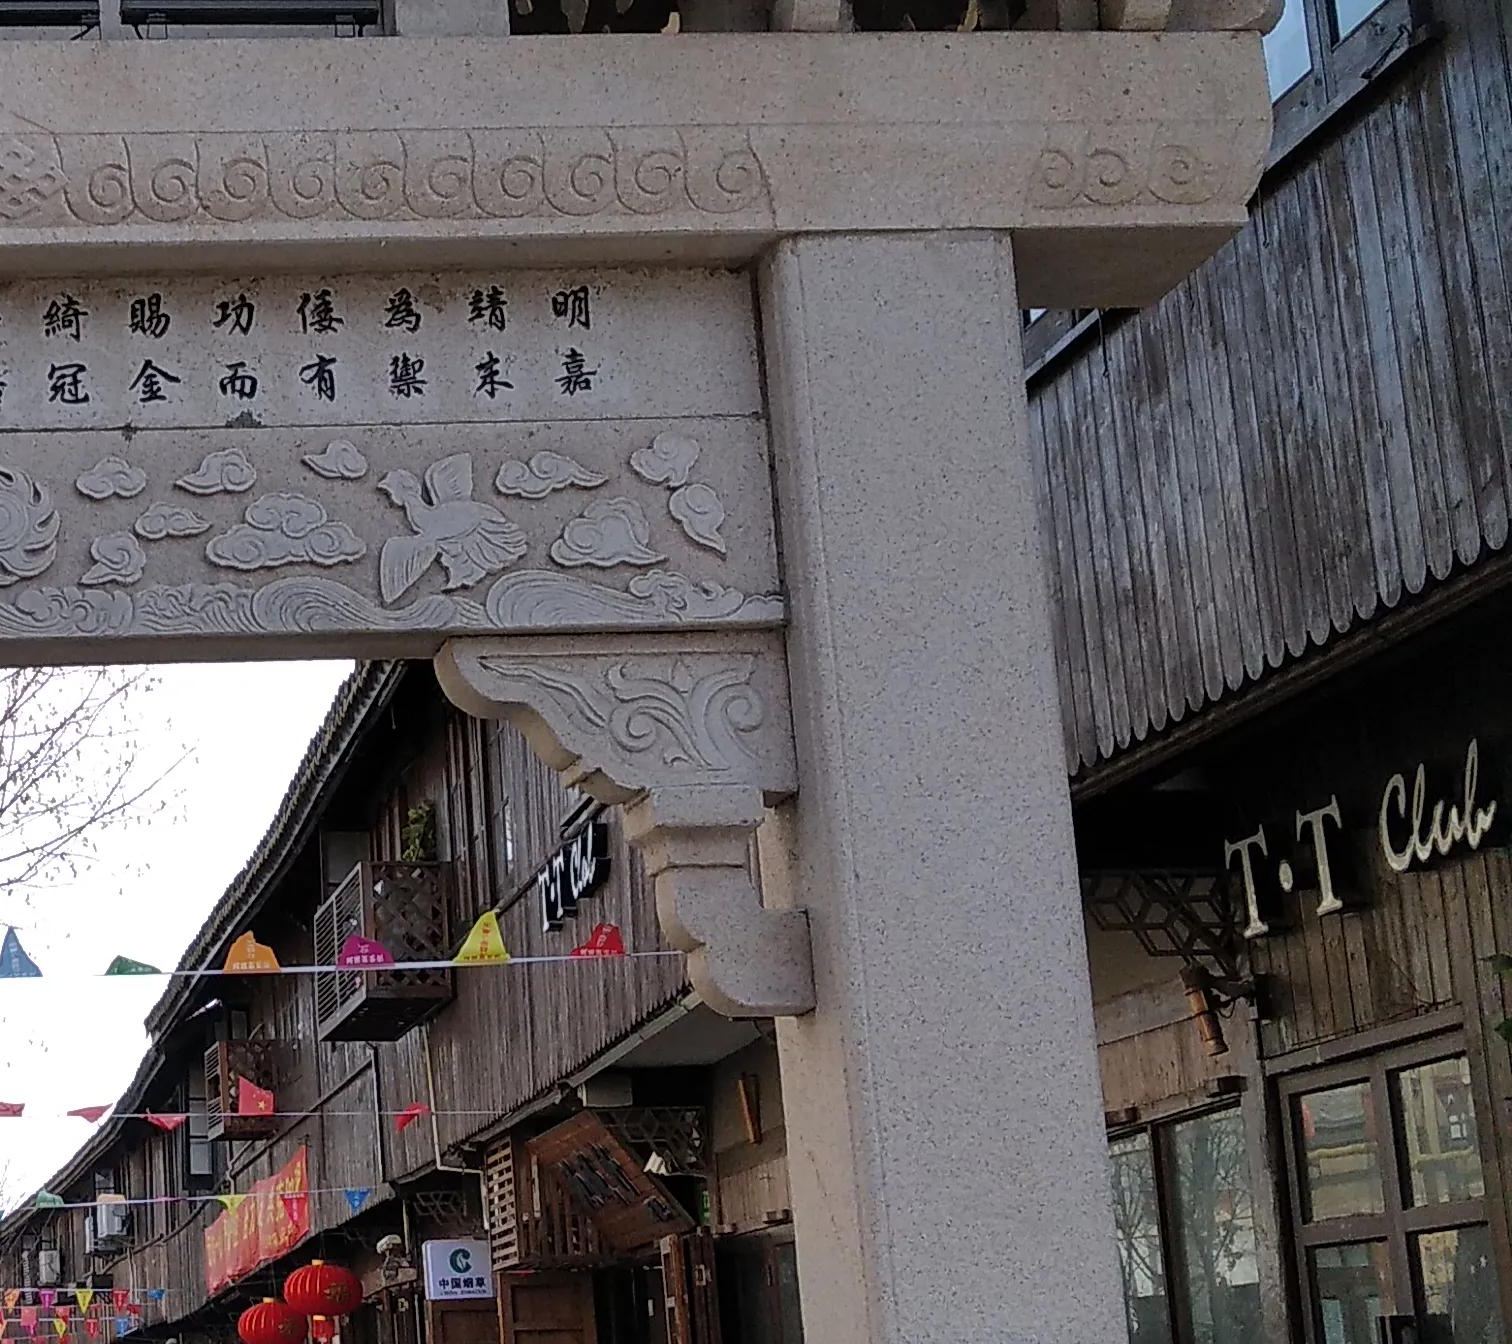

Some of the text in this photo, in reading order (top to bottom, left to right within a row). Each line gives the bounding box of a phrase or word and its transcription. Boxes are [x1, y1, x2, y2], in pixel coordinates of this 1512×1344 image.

[1380, 737, 1498, 873] Club
[439, 1277, 486, 1290] 中国烟草
